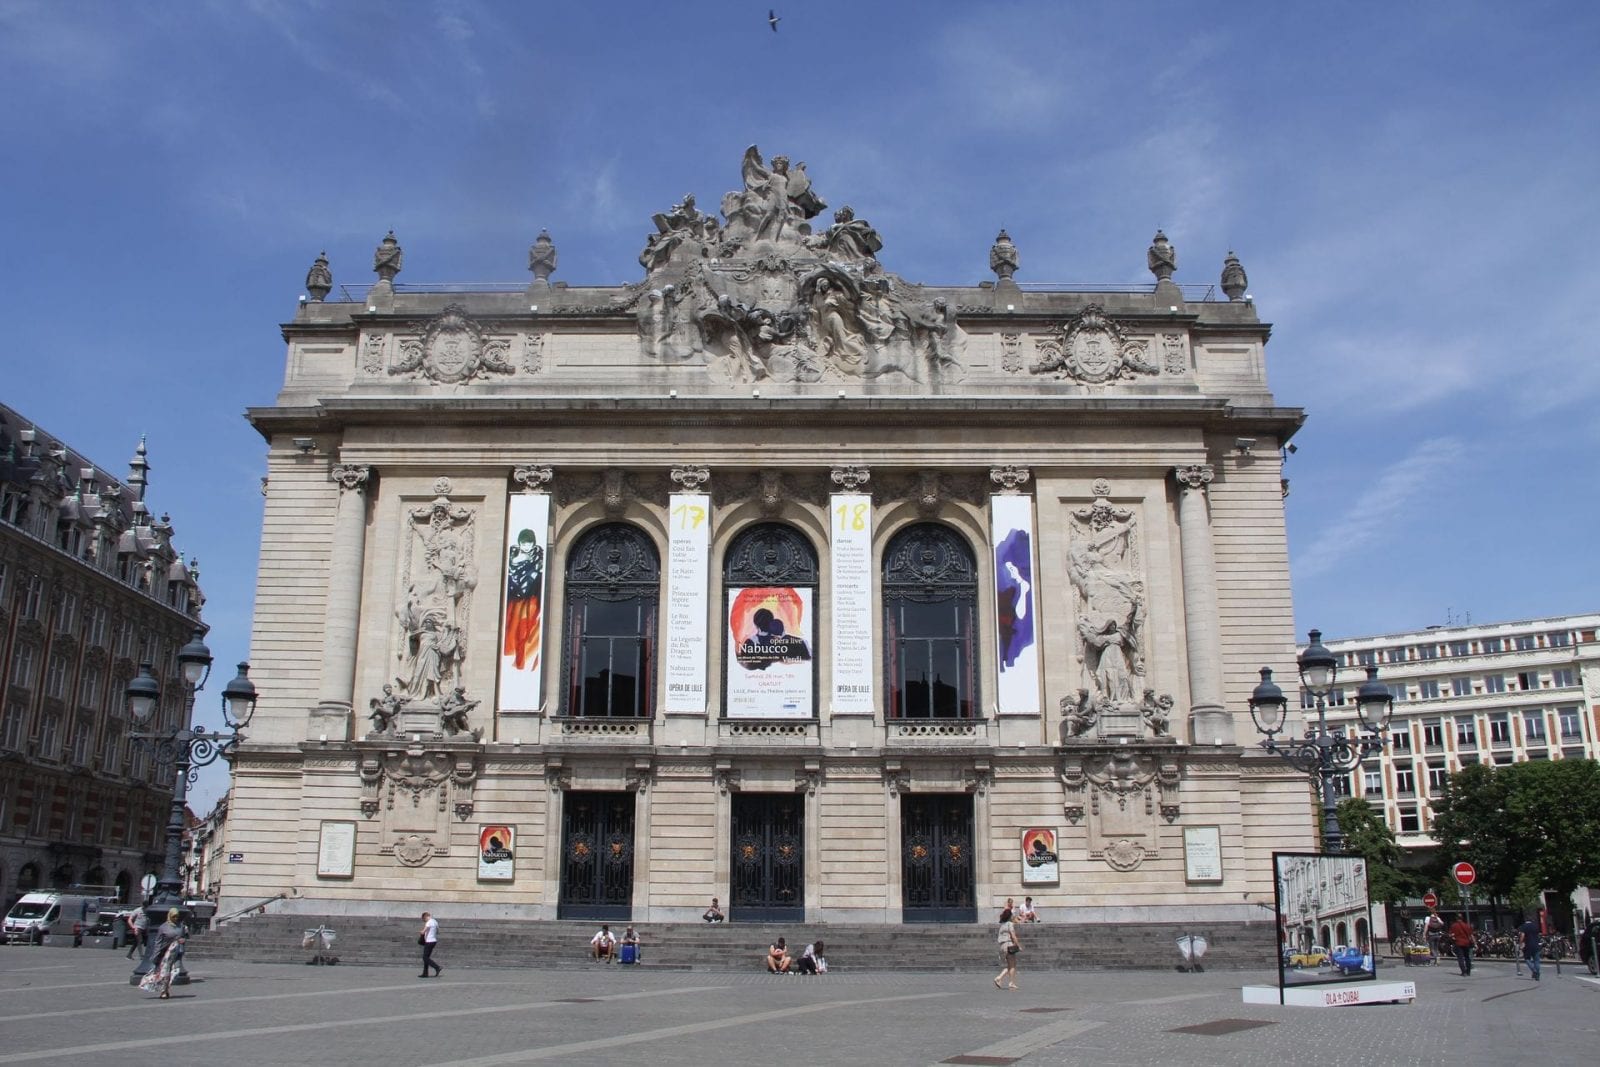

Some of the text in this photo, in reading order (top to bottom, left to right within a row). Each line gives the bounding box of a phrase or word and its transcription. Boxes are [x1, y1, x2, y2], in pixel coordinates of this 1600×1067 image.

[671, 504, 705, 530] 17
[836, 503, 867, 531] 18
[738, 643, 788, 654] Nabucco
